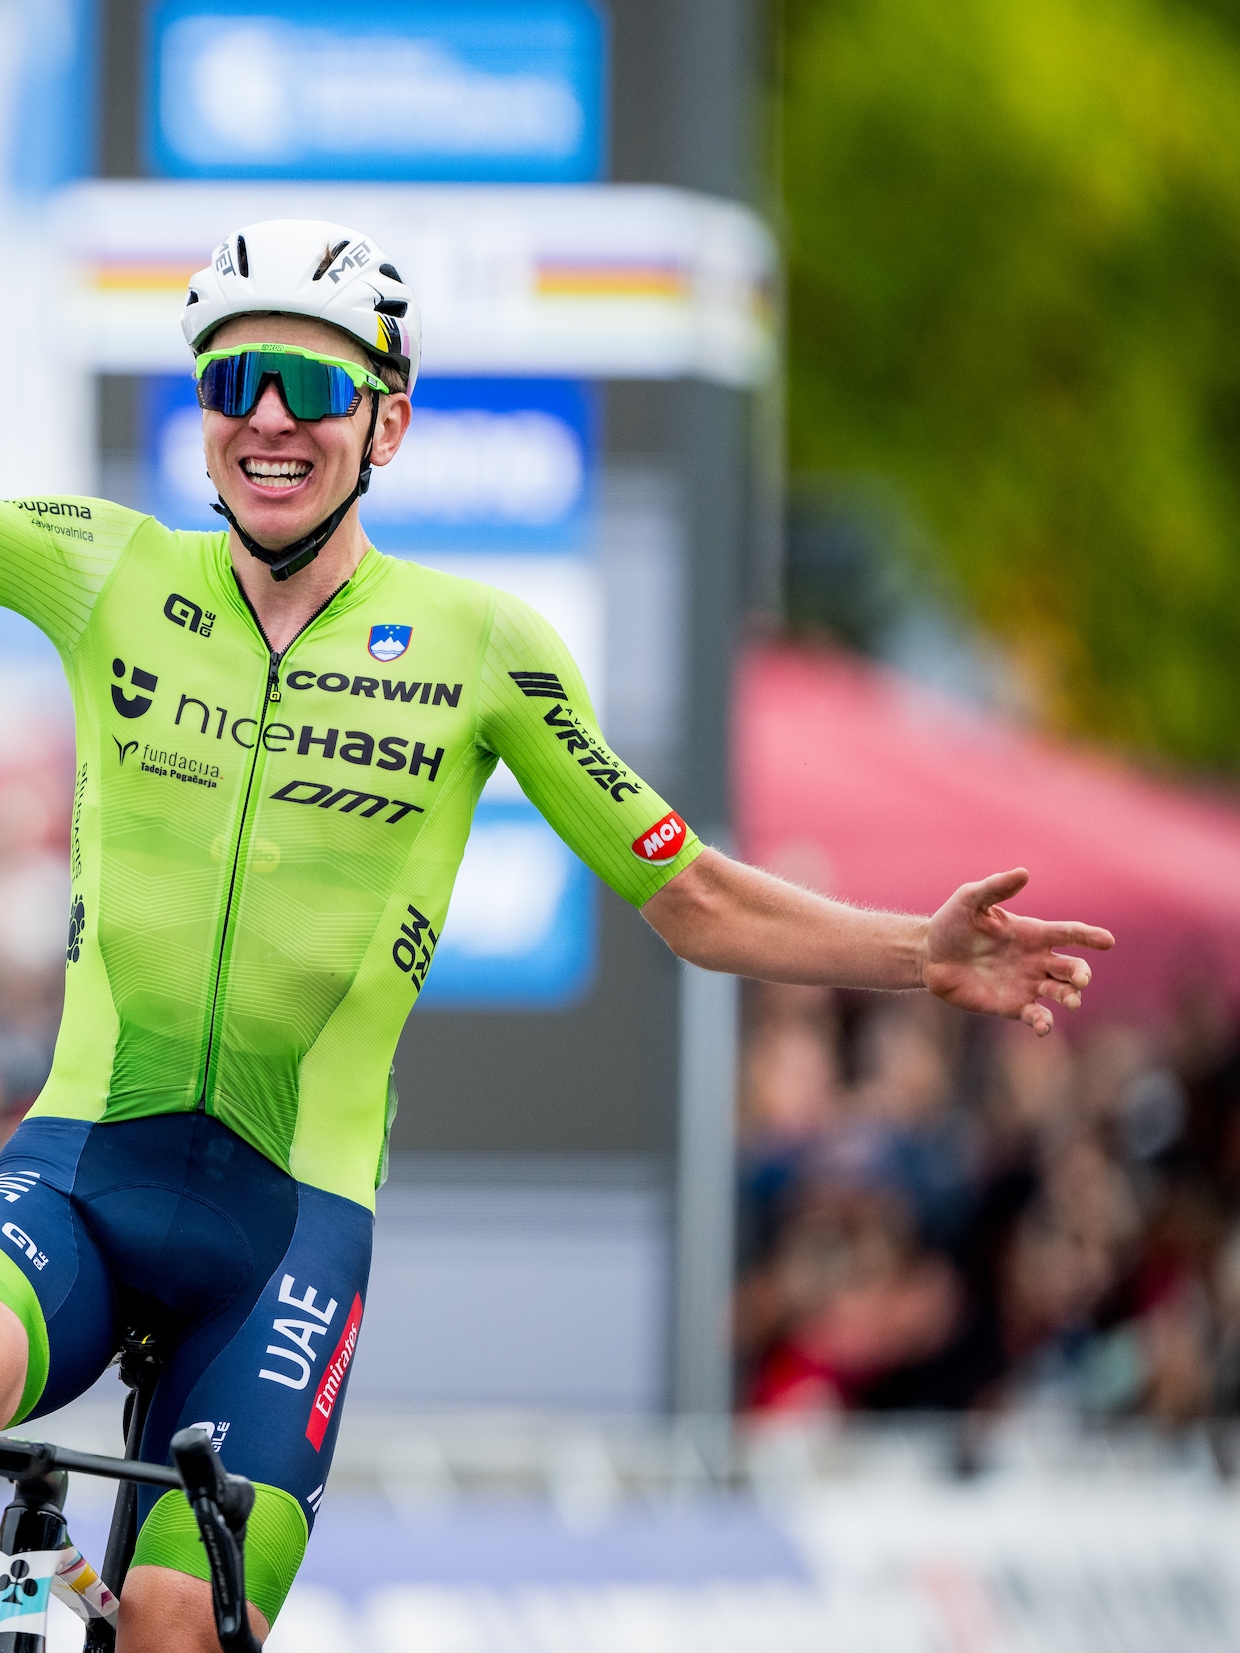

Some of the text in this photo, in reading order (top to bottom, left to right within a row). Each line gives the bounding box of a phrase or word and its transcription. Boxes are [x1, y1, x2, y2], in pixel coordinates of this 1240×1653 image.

[215, 236, 237, 276] MET
[327, 240, 372, 284] MET
[286, 670, 463, 709] CORWIN
[141, 761, 217, 788] Tadeja Pogačarja
[269, 780, 425, 824] DMT
[643, 818, 682, 858] MOL
[258, 1273, 338, 1390] UAE
[315, 1322, 358, 1419] Emirates
